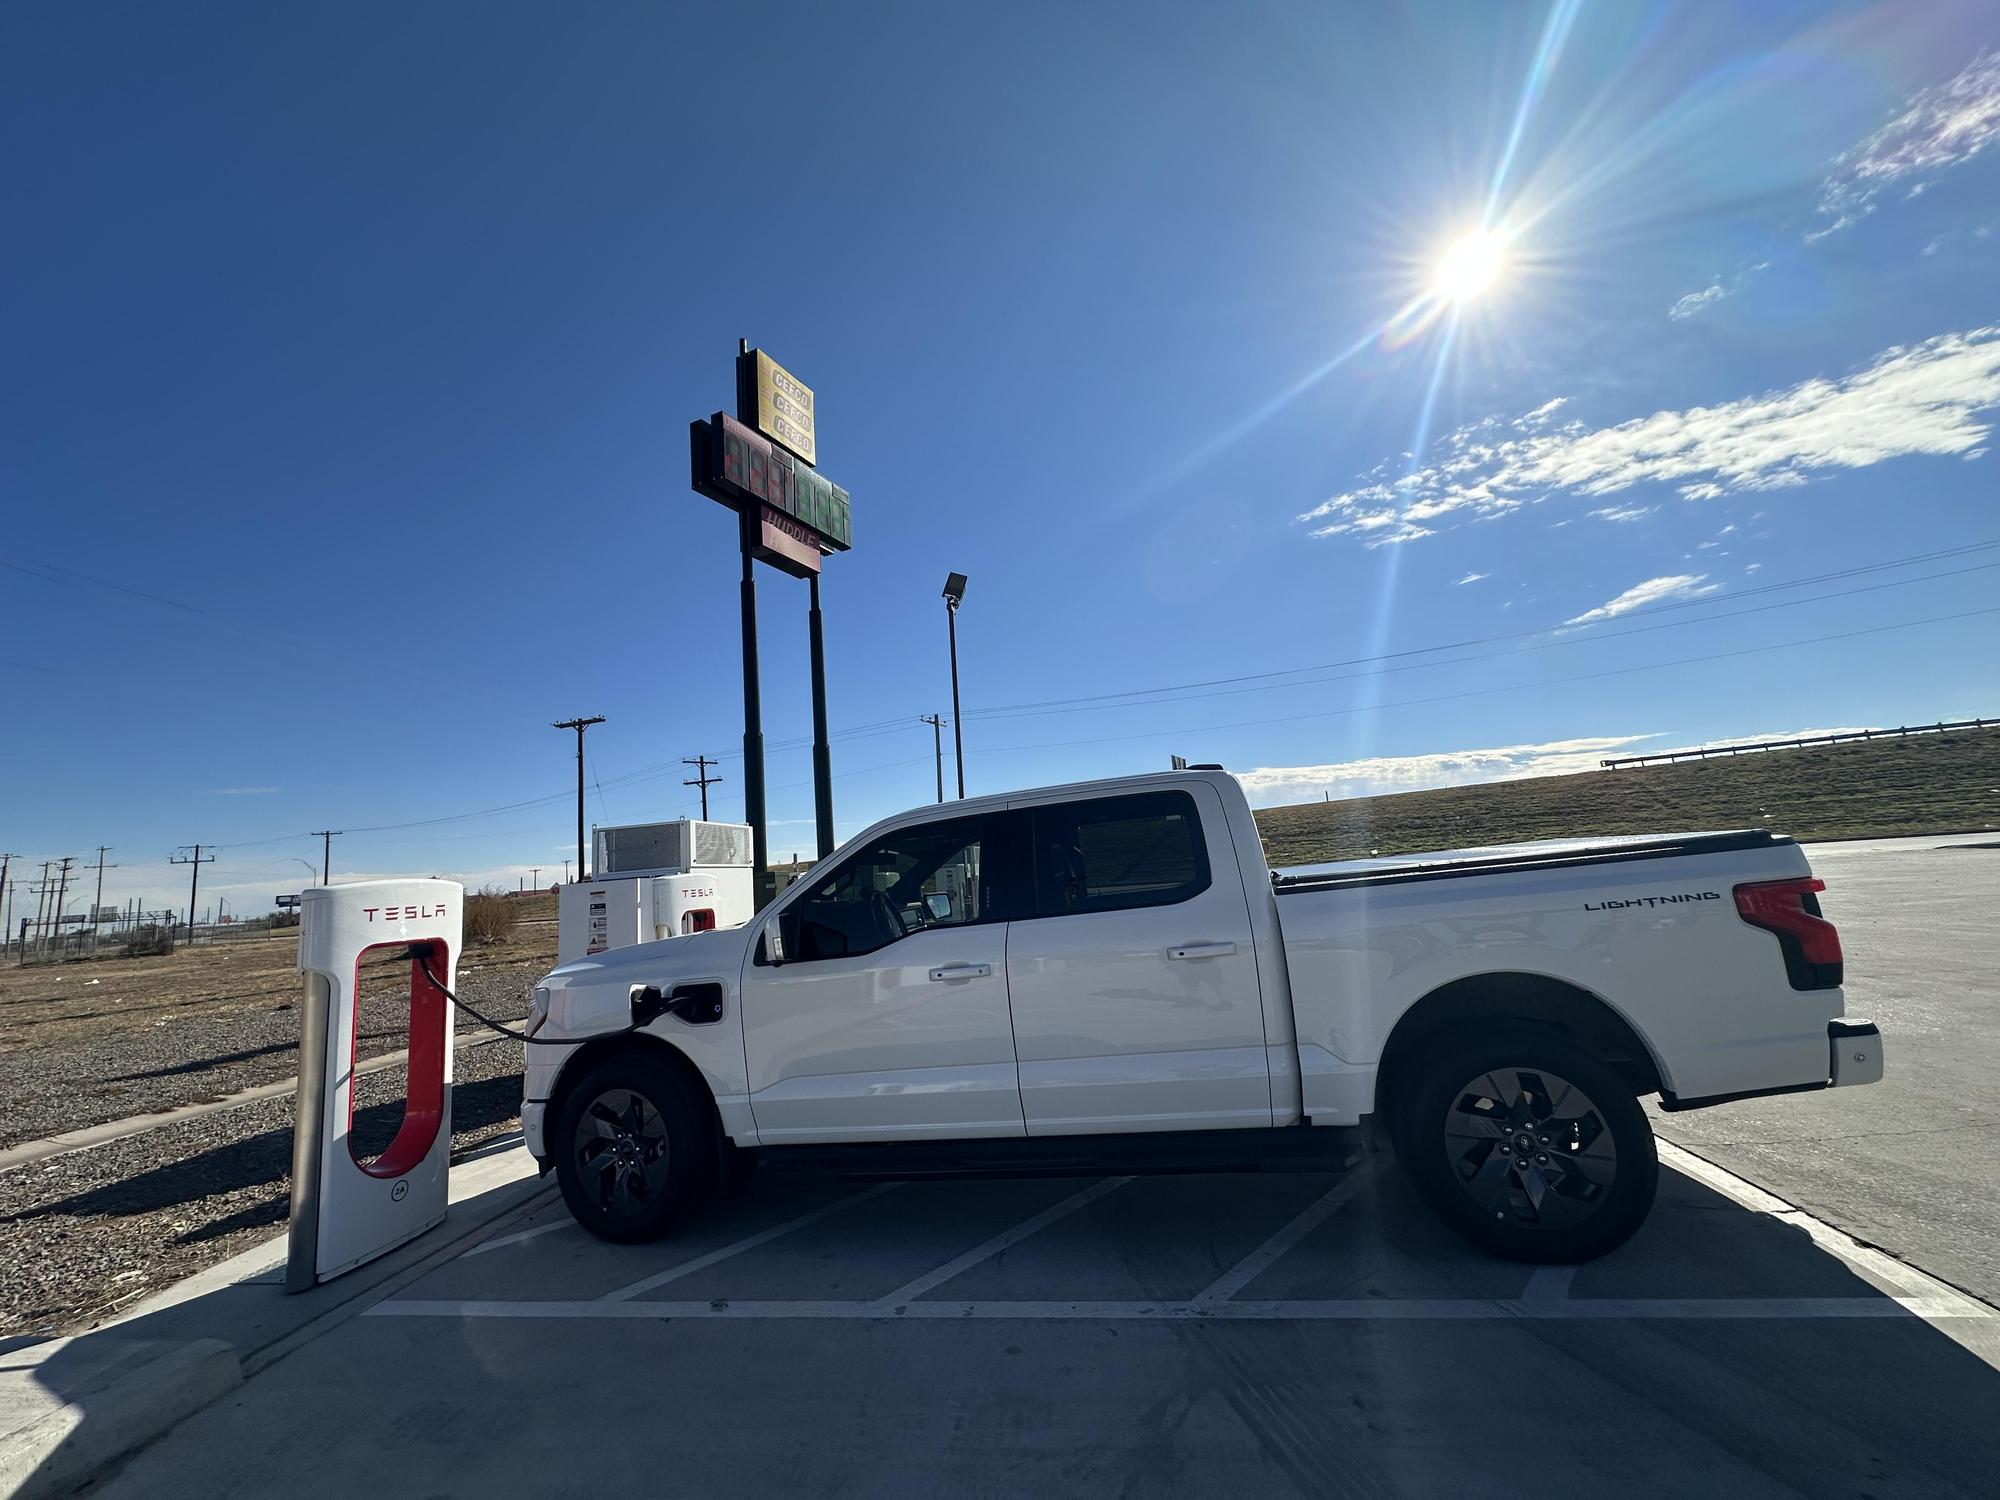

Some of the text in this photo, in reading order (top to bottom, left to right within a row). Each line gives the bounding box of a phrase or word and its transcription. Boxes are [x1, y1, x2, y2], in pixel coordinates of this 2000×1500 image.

[776, 373, 808, 406] CEFCO
[777, 397, 809, 428] CEFCO
[778, 418, 810, 450] CEFCO
[767, 511, 816, 547] HUDDLE
[682, 888, 714, 899] TESLA
[1584, 891, 1721, 911] LIGHTNING
[363, 904, 446, 922] TESLA
